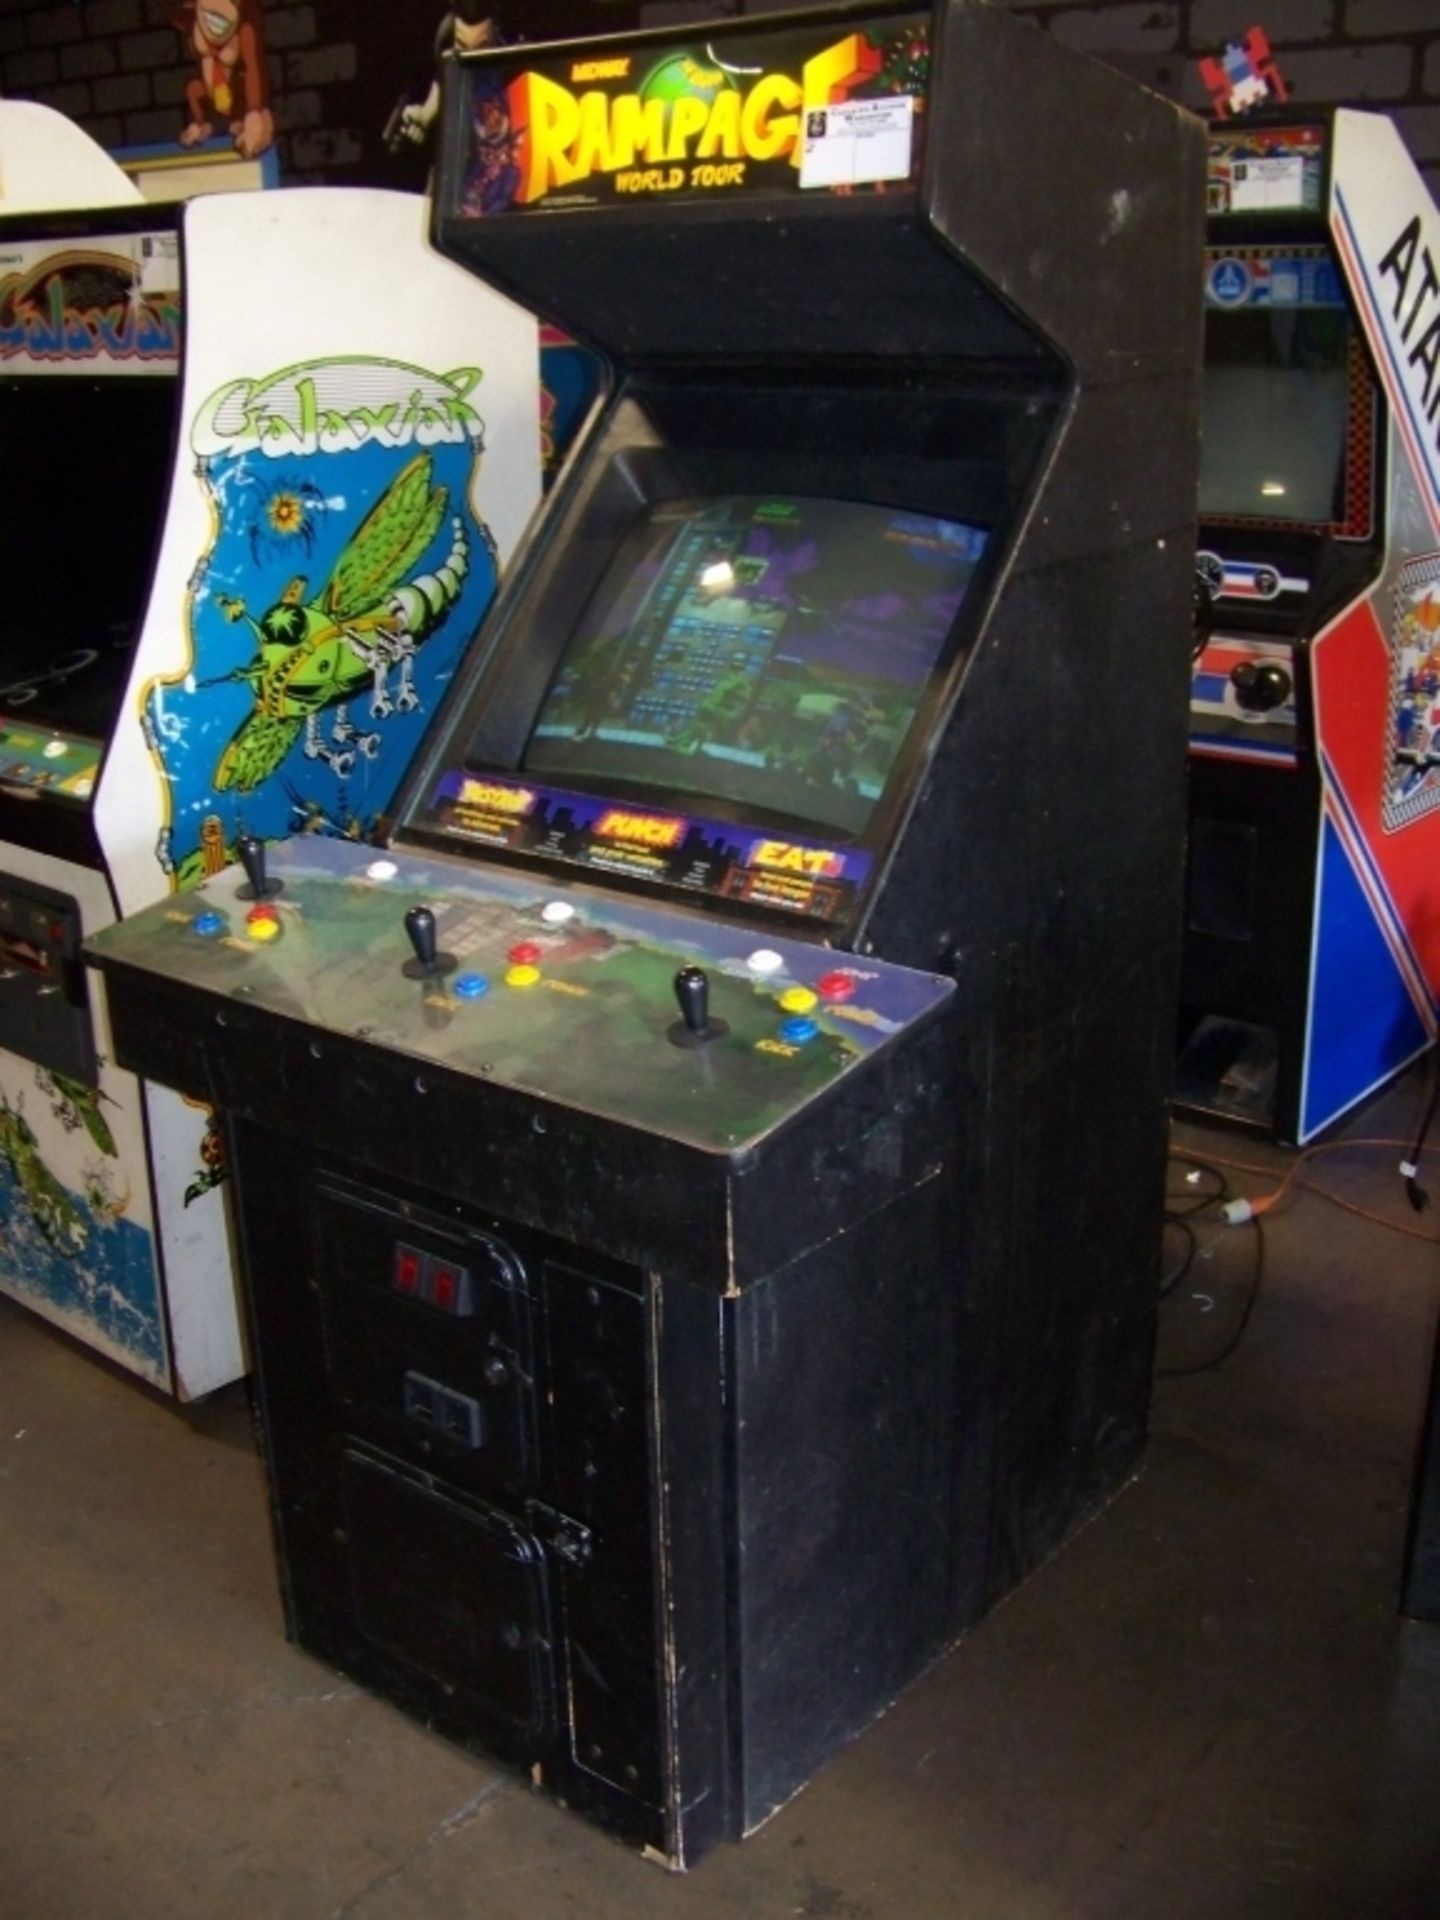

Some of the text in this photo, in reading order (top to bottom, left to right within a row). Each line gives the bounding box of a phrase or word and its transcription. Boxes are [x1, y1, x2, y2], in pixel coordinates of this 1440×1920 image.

[616, 162, 746, 193] WORLD TOUR
[1378, 214, 1440, 456] ATA
[190, 355, 486, 458] Galaxian
[598, 808, 685, 848] PUNCH
[752, 839, 842, 876] EAT
